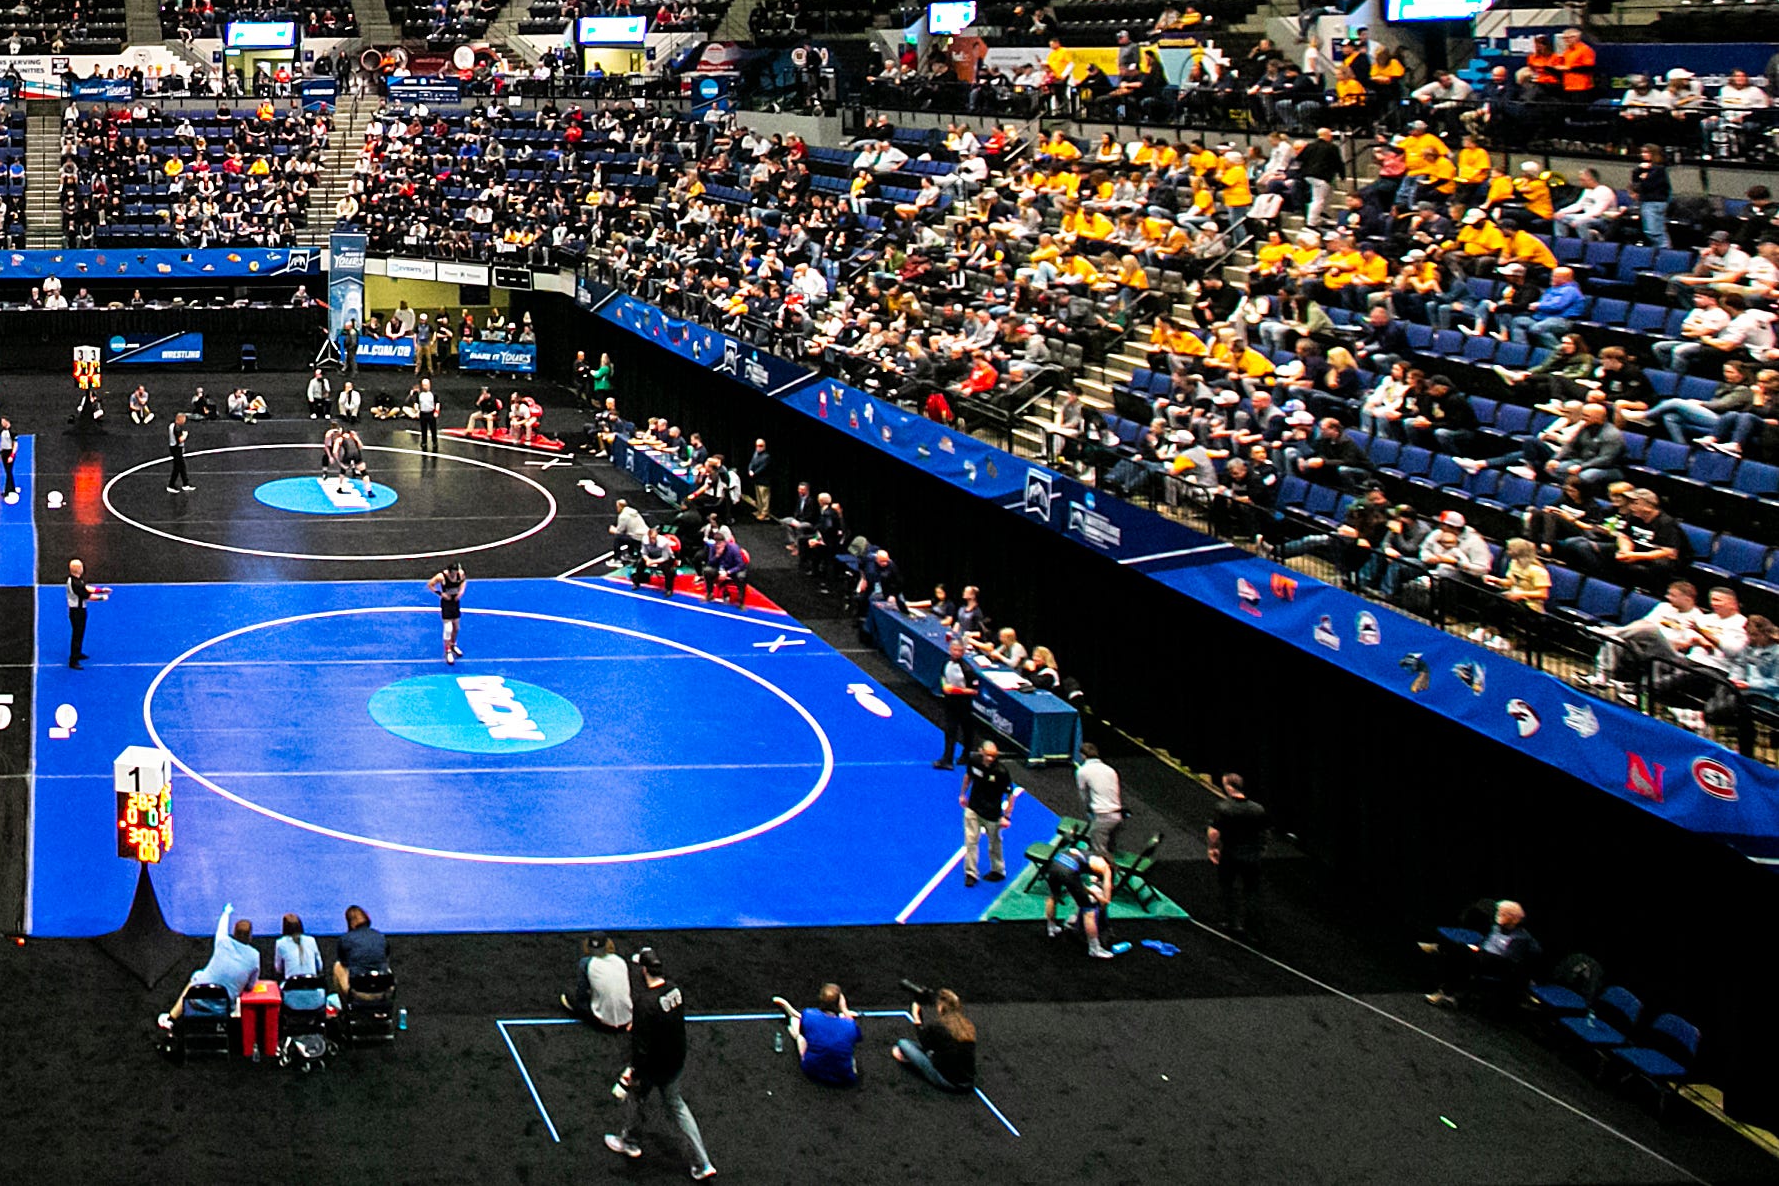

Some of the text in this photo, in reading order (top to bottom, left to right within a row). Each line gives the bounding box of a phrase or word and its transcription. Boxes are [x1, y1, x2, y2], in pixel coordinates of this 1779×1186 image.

[78, 349, 84, 360] 3
[90, 349, 96, 360] 3
[161, 350, 201, 359] WRESTLING
[356, 344, 412, 357] AA.COM/D2
[128, 766, 140, 792] 1
[126, 808, 159, 827] 0 0
